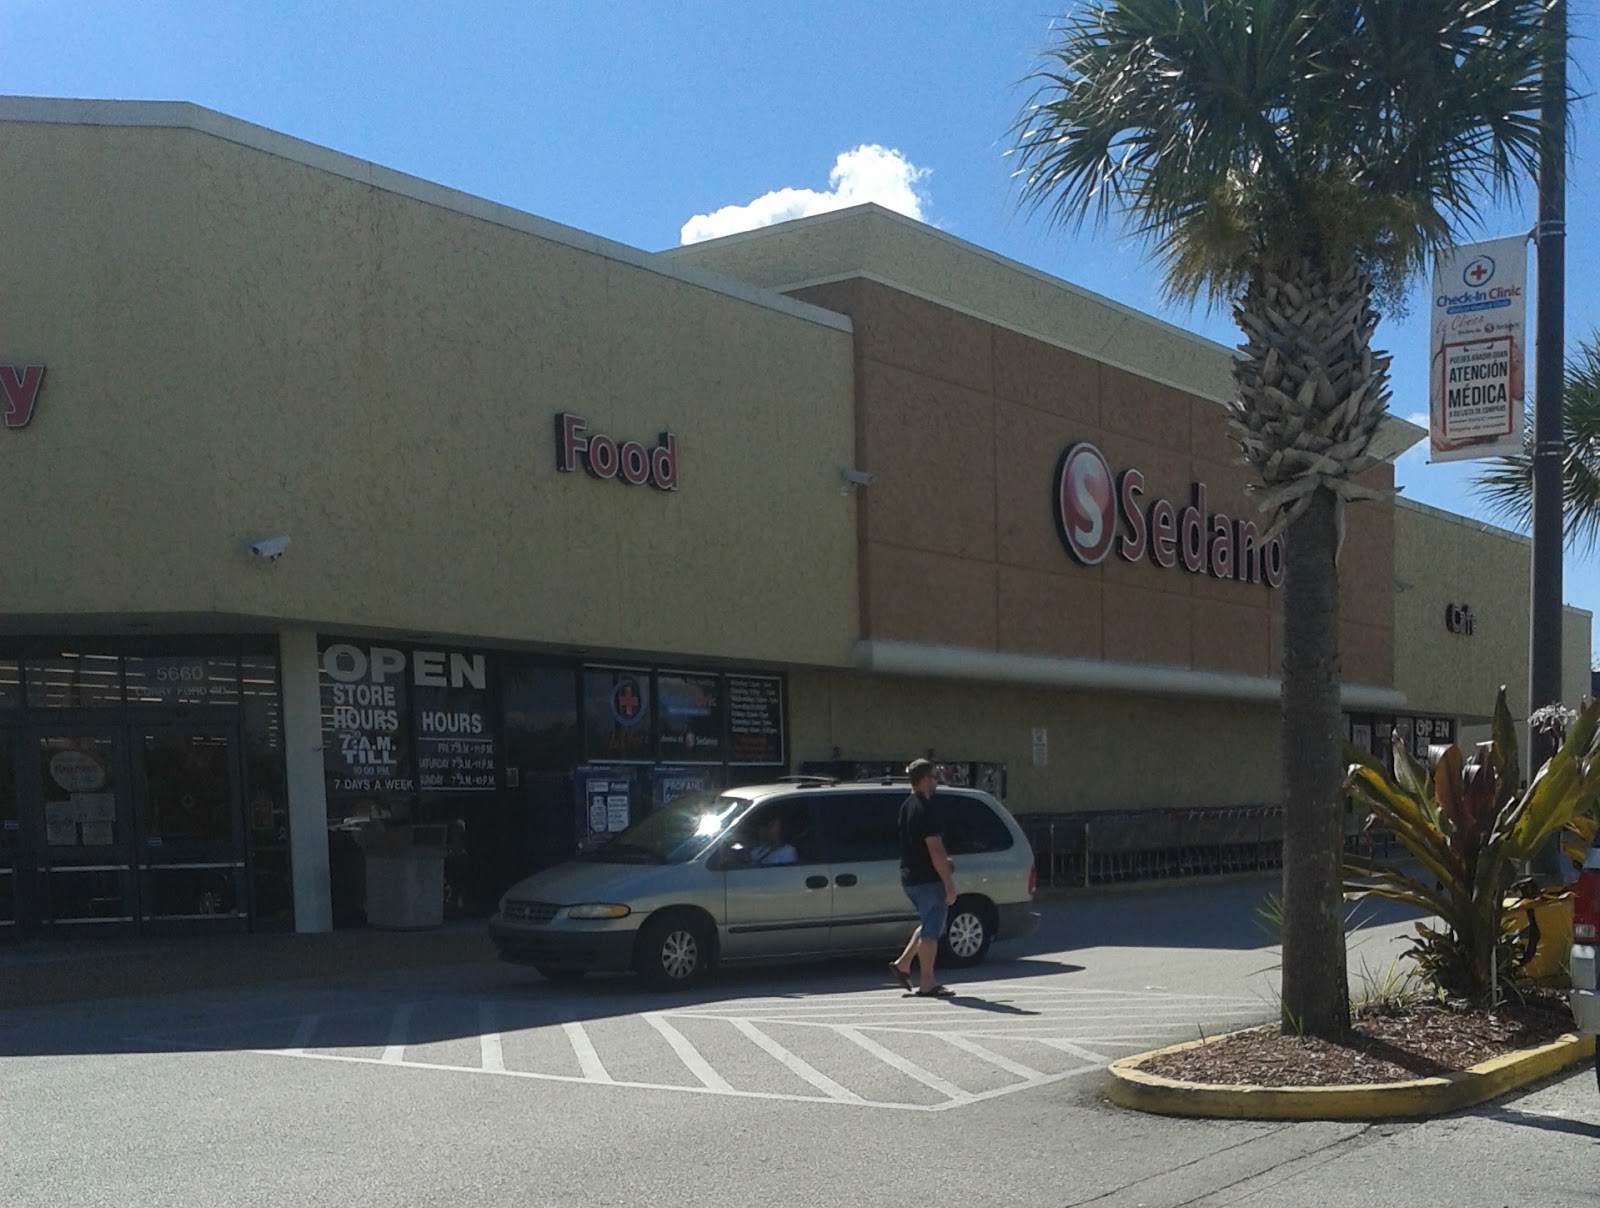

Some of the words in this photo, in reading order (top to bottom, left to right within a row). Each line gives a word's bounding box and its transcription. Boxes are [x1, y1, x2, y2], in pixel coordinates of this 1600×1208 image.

[1436, 291, 1487, 307] Check-In
[1489, 285, 1522, 299] Clinic
[1449, 360, 1508, 383] ATENCIÓN
[1448, 383, 1507, 408] MÉDICA
[555, 412, 678, 491] Food
[156, 666, 204, 681] 5660
[323, 644, 487, 689] OPEN
[333, 683, 396, 706] STORE
[334, 707, 399, 730] HOURS
[422, 711, 482, 734] HOURS
[1416, 719, 1450, 738] OPEN
[342, 750, 397, 765] TILL
[334, 779, 341, 790] 7
[344, 779, 371, 791] DAYS
[374, 780, 382, 791] A
[385, 779, 414, 791] WEEK
[665, 780, 702, 791] PROPANE
